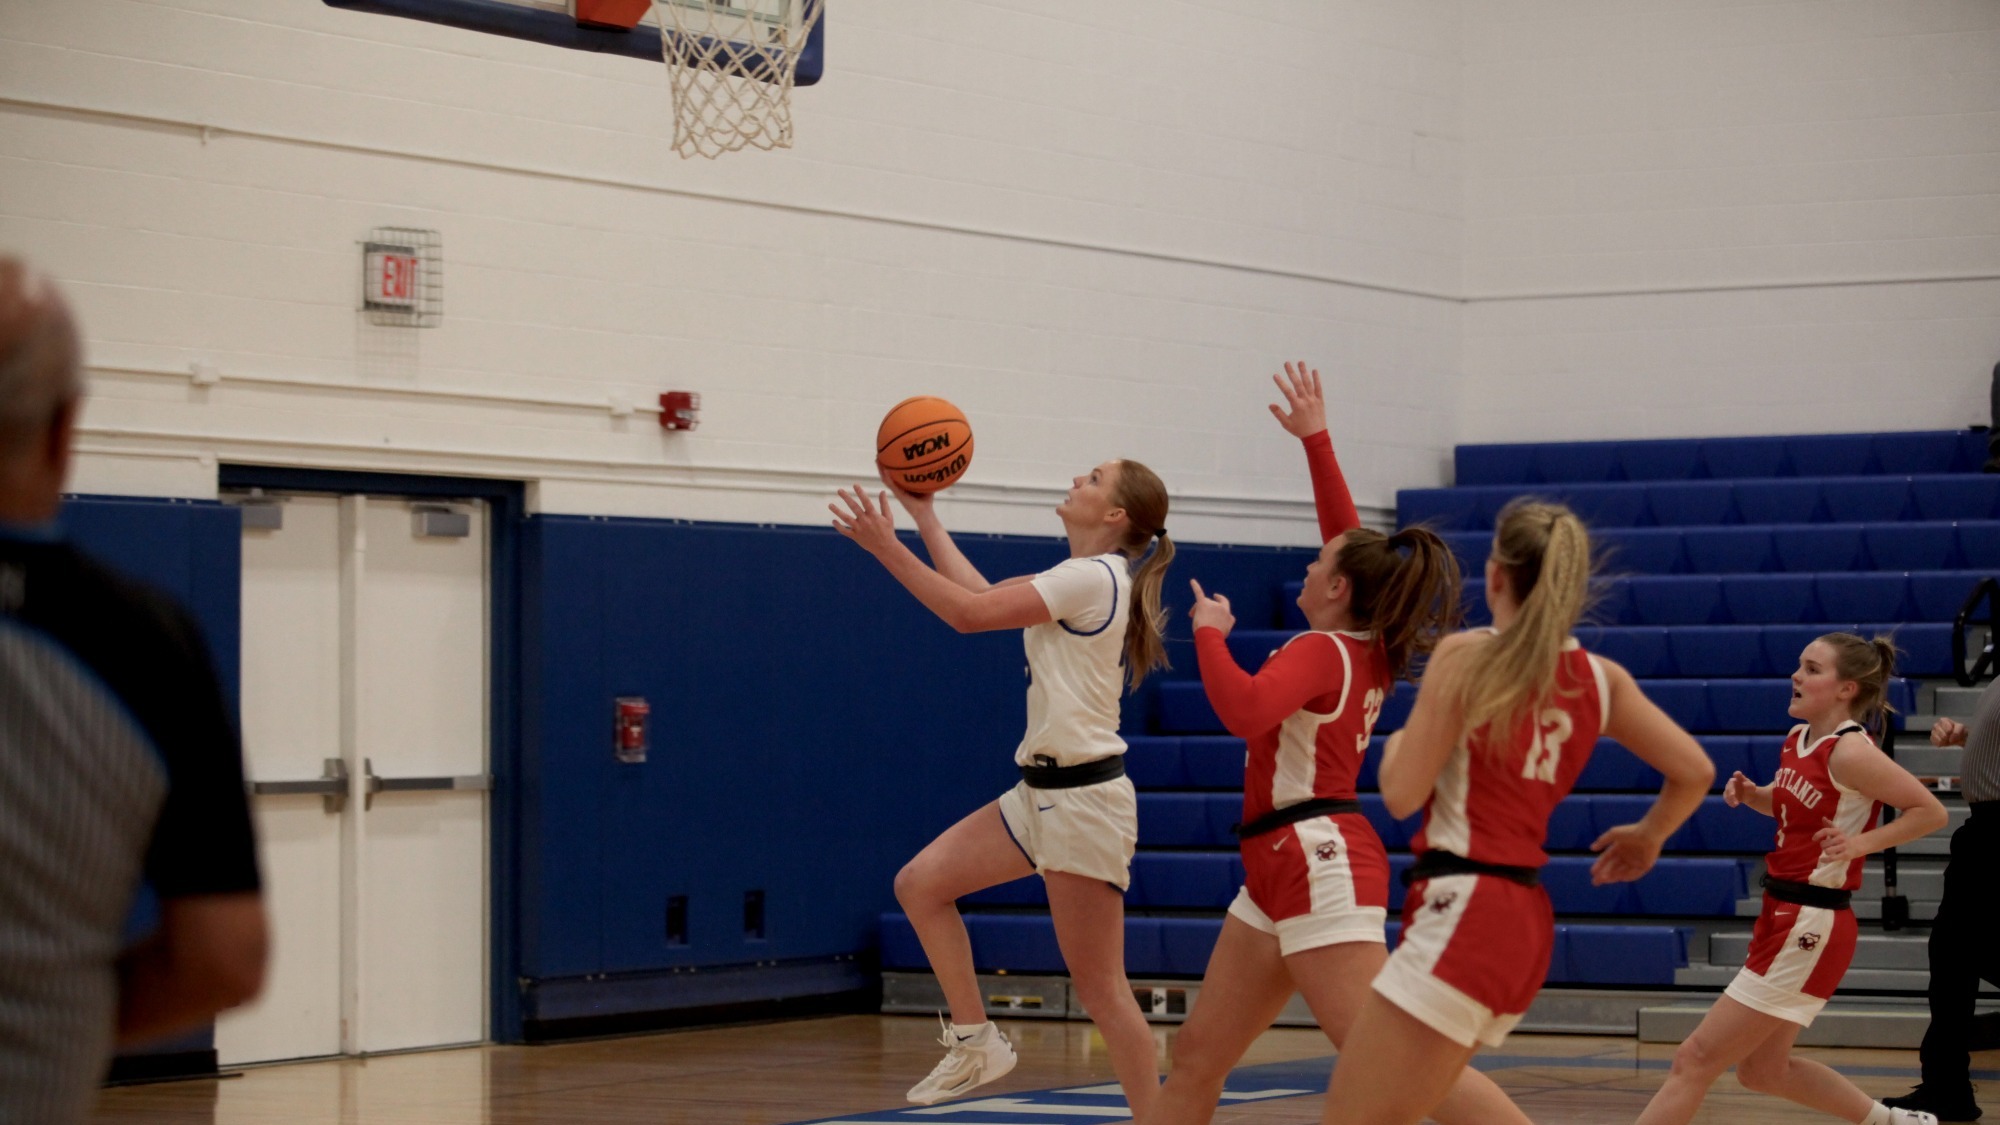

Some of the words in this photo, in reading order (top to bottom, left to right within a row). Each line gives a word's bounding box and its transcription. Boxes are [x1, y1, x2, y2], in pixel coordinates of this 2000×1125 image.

[382, 255, 417, 299] EXIT
[903, 432, 950, 461] NCAA
[903, 454, 967, 483] Wilson
[1521, 706, 1573, 785] 13
[1773, 767, 1823, 810] RTLAND
